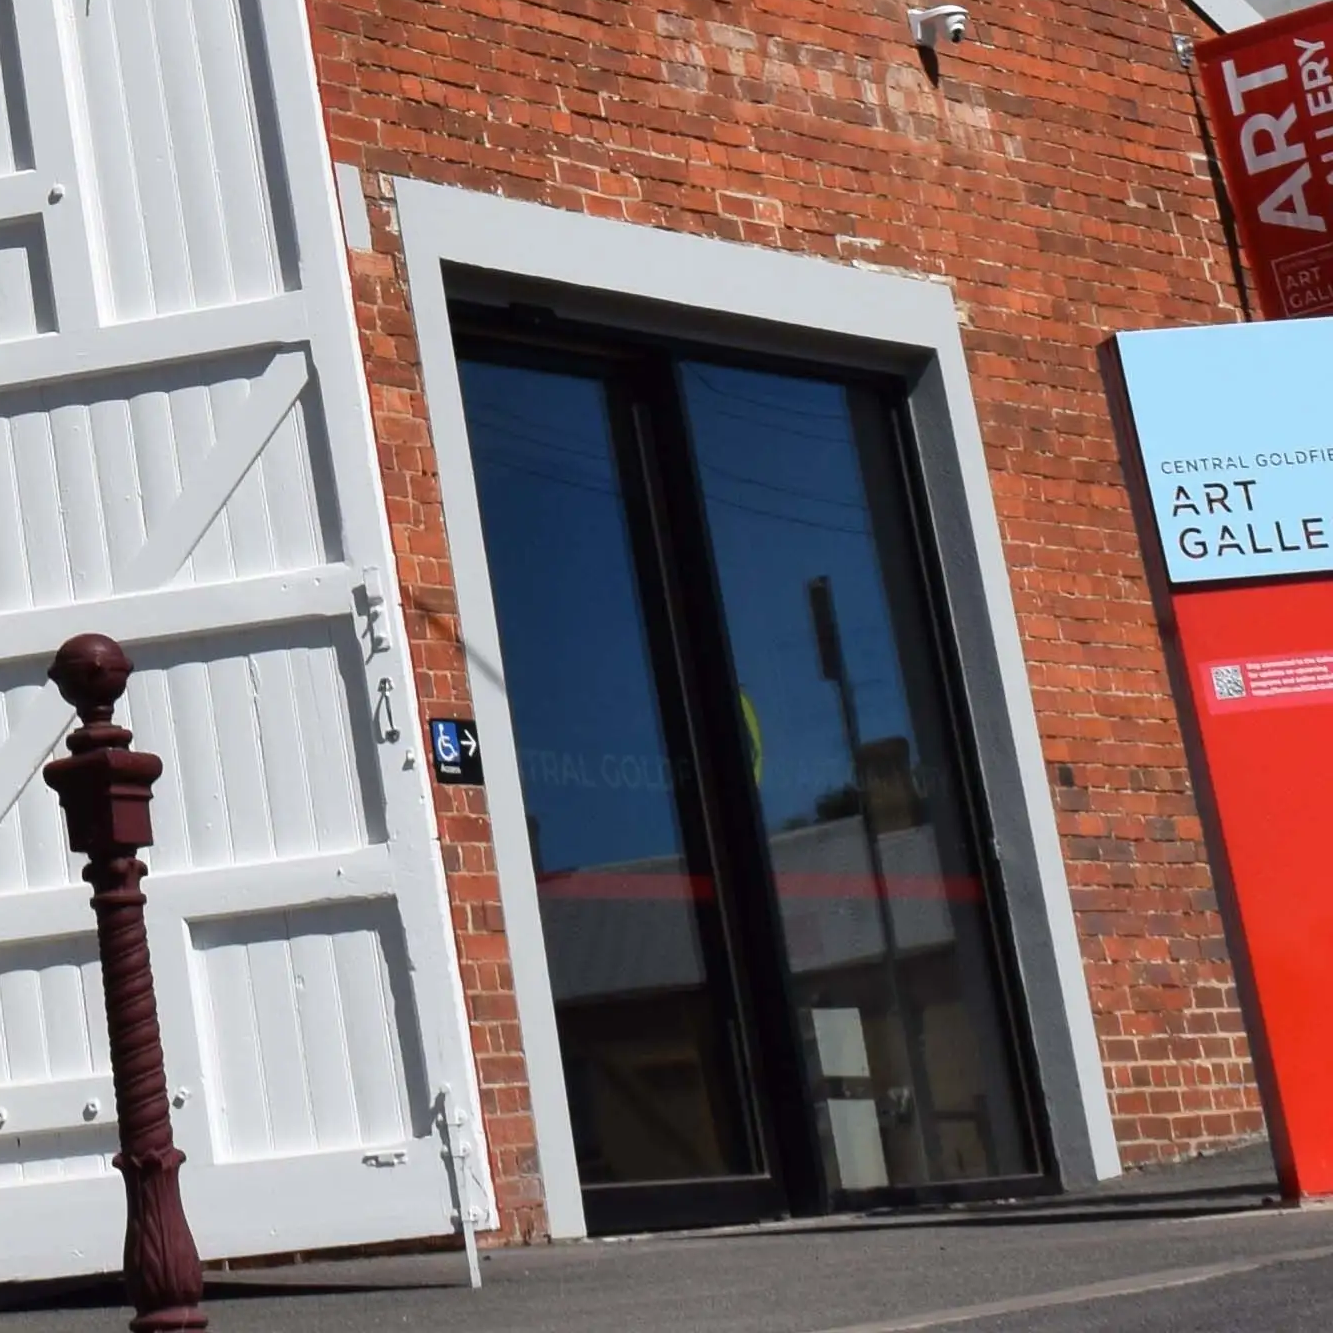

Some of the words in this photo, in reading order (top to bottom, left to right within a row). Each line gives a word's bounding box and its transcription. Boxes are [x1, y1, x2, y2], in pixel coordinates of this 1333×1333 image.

[1222, 58, 1327, 232] ART
[1161, 455, 1249, 474] CENTRAL
[1255, 448, 1333, 468] GOLDFIE
[1173, 480, 1256, 517] ART
[1179, 518, 1329, 559] GALLE
